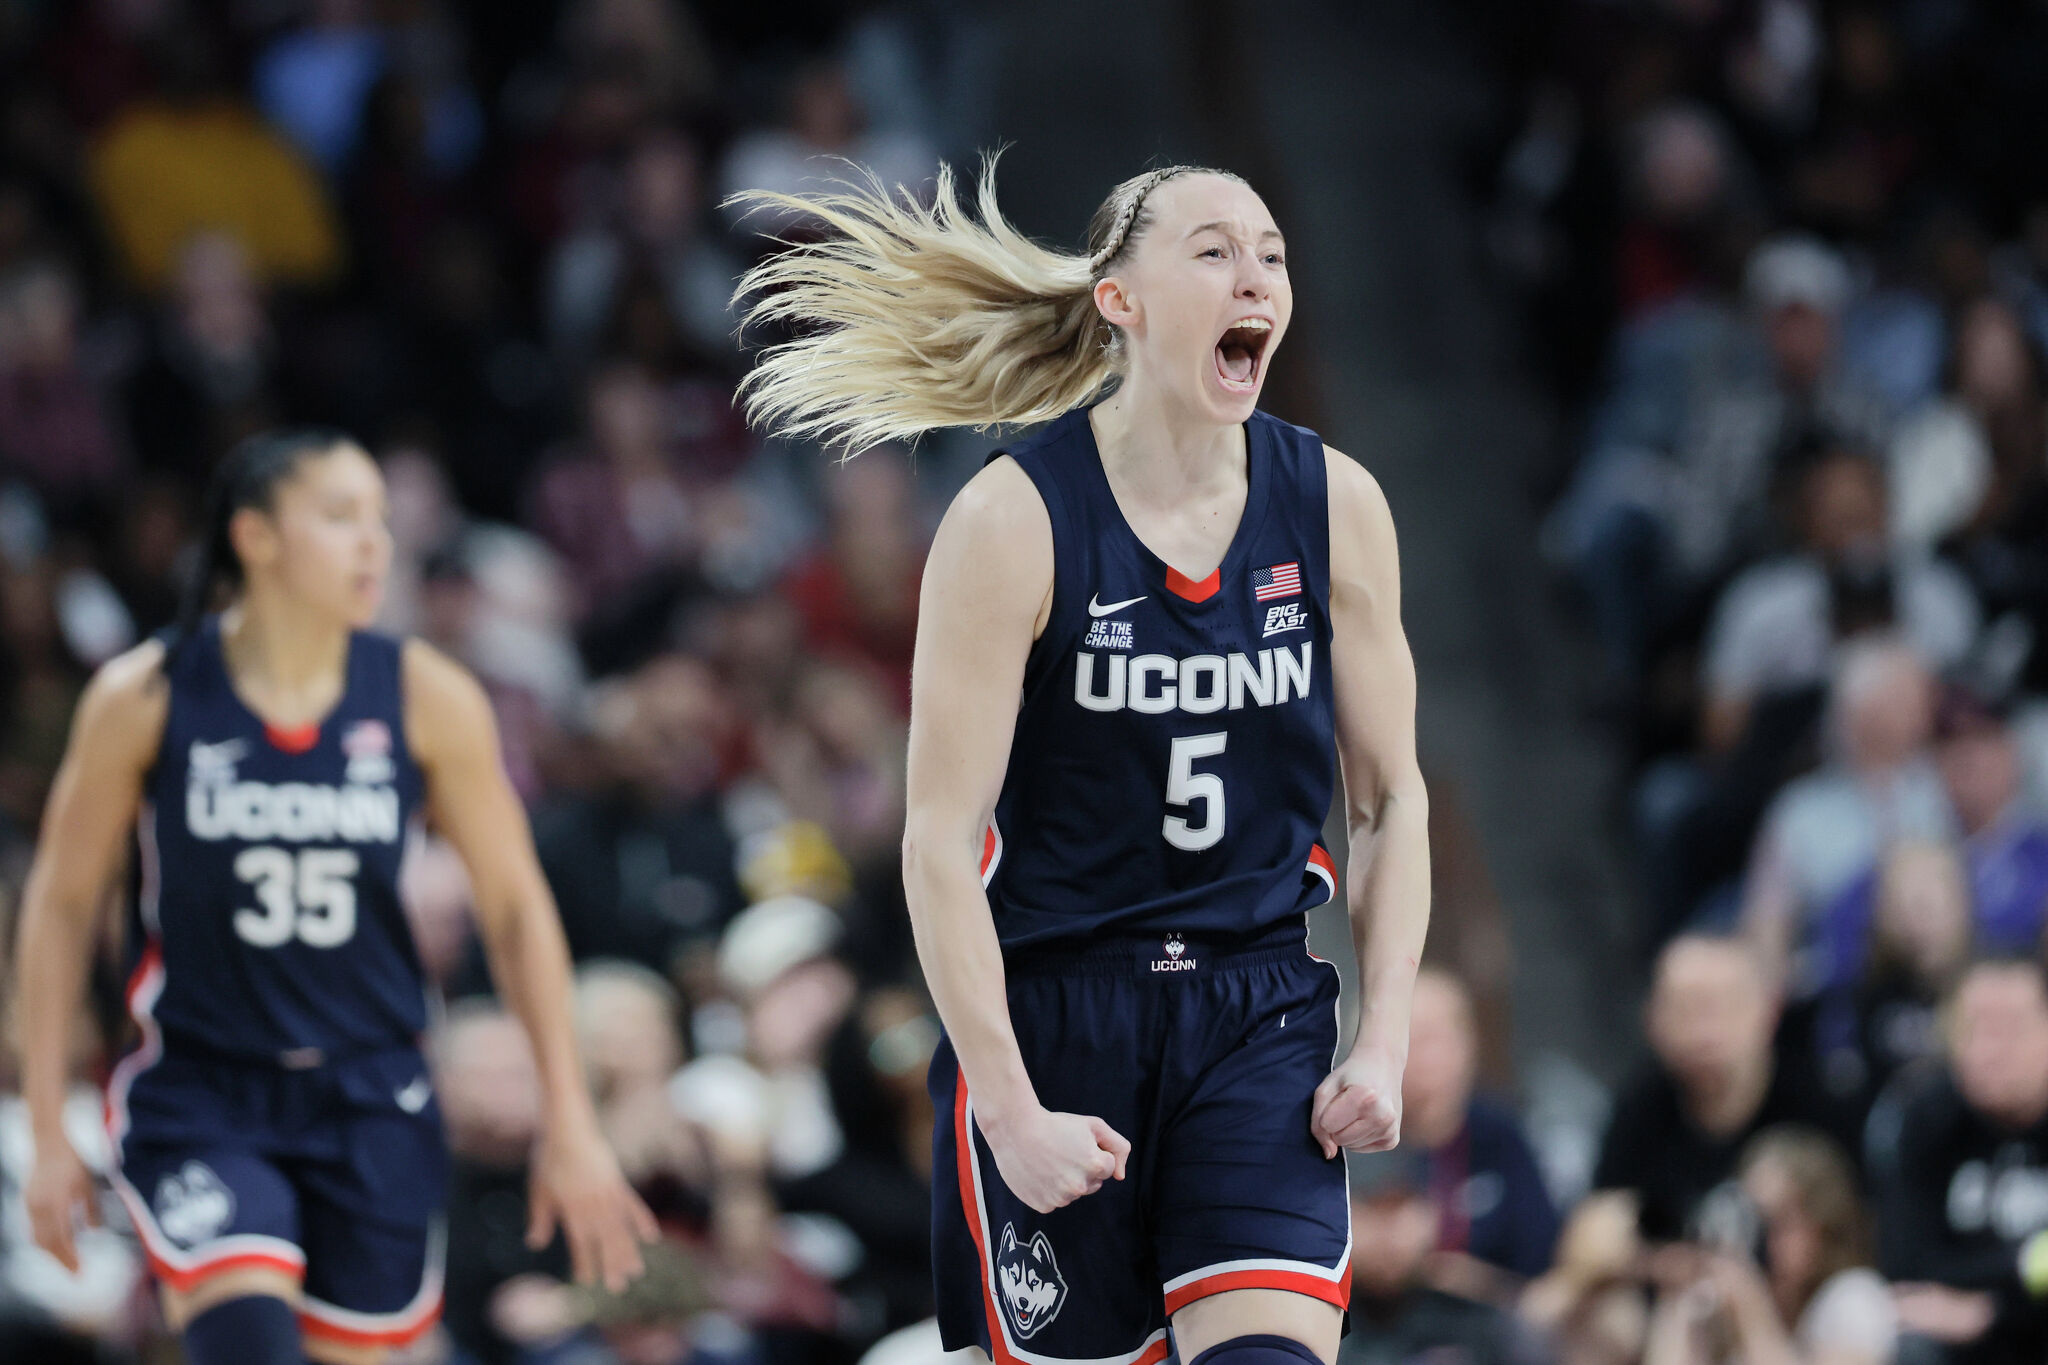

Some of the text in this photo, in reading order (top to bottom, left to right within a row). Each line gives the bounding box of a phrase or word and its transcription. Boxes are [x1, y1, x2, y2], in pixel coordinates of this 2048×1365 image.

[1266, 603, 1300, 619] BIG
[1090, 621, 1132, 636] BE THE
[1264, 612, 1308, 632] EAST
[1084, 633, 1134, 649] CHANGE
[1074, 641, 1312, 714] UCONN
[1162, 731, 1228, 851] 5
[187, 781, 398, 843] UCONN
[234, 847, 358, 947] 35
[1151, 959, 1196, 972] UCONN
